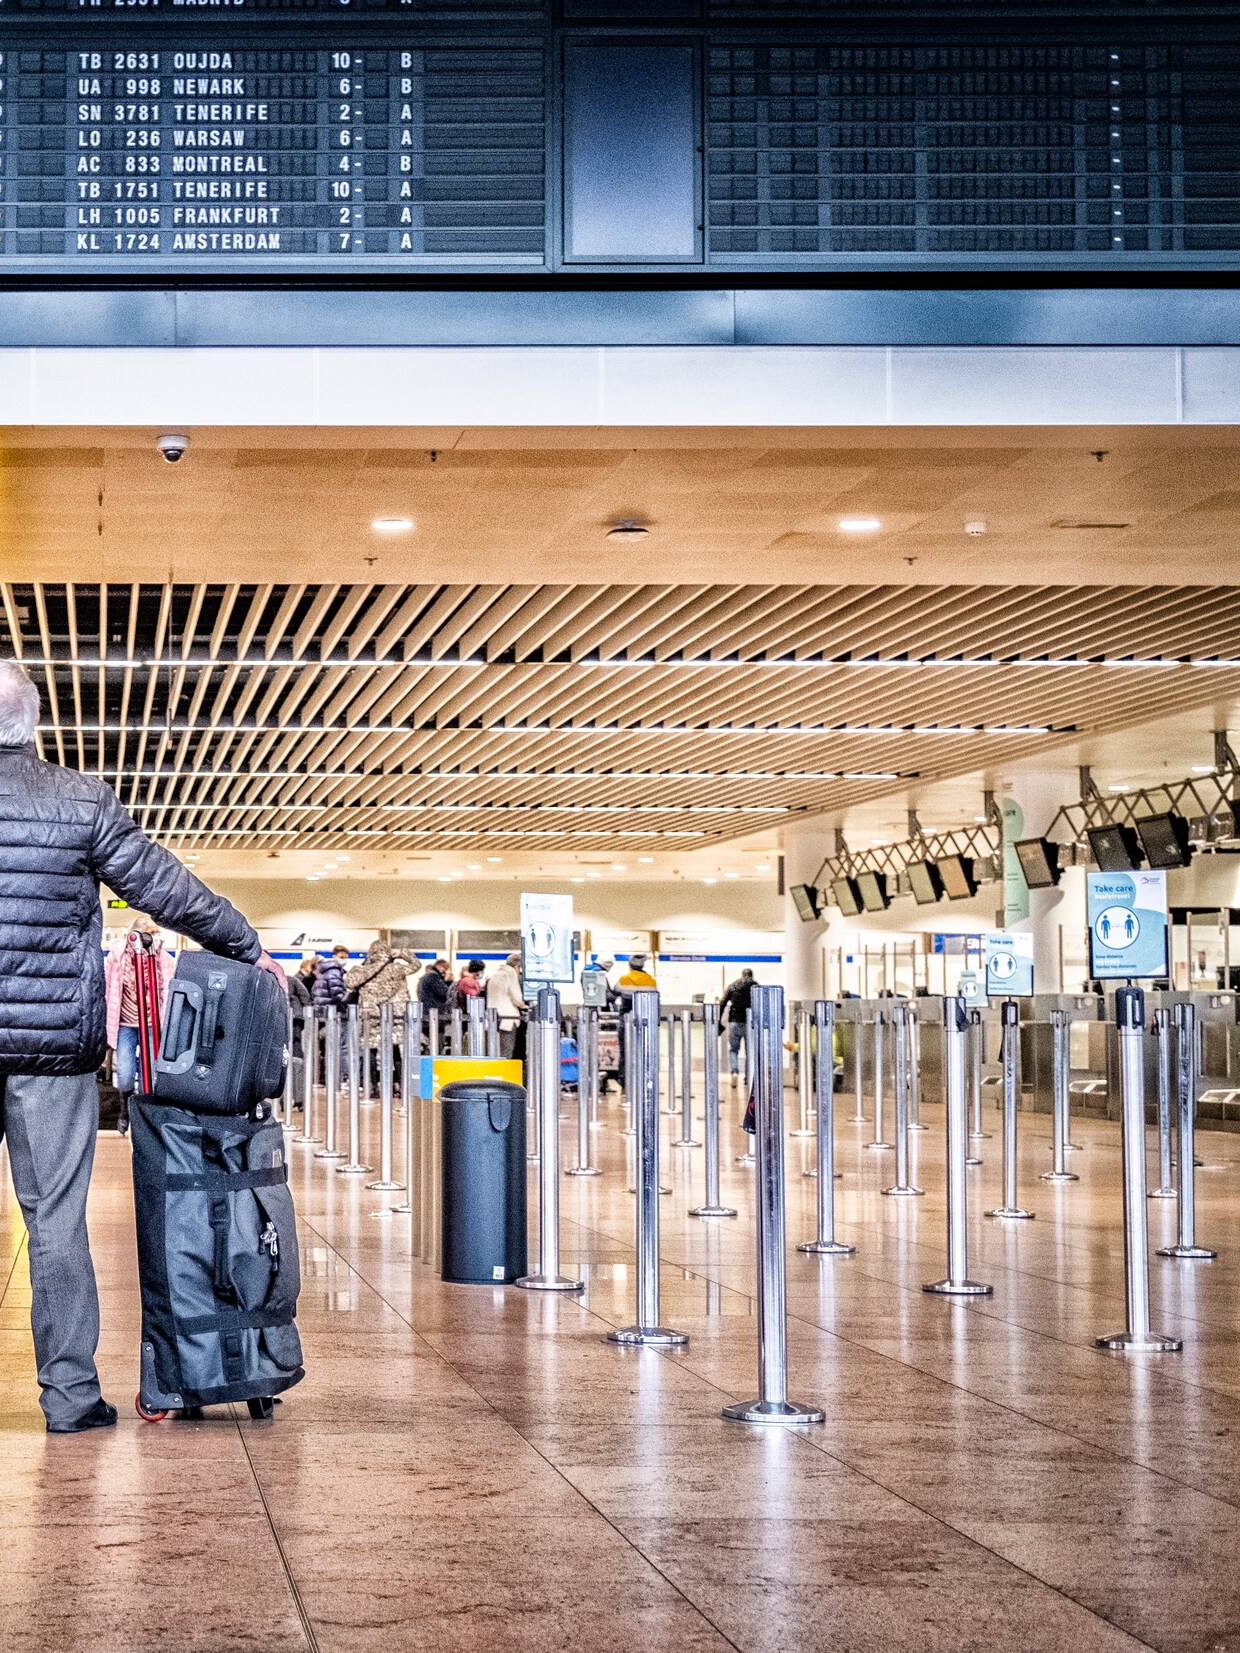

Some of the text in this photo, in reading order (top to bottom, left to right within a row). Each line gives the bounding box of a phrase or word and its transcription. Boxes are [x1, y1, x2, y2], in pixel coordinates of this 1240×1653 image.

[80, 54, 101, 68] TB
[115, 54, 158, 68] 2631
[174, 53, 232, 68] OUJDA
[402, 53, 411, 67] B
[79, 79, 100, 94] UA
[127, 79, 160, 94] 998
[174, 79, 244, 94] NEWARK
[402, 79, 411, 93] B
[79, 105, 101, 120] SN
[115, 105, 158, 120] 3781
[175, 105, 267, 120] TENERIFE
[401, 104, 411, 119] A
[79, 131, 100, 146] LO
[127, 131, 160, 146] 236
[174, 130, 244, 146] WARSAW
[401, 130, 411, 144] A
[78, 157, 100, 172] AC
[126, 157, 159, 172] 833
[173, 156, 267, 171] MONTREAL
[401, 156, 410, 171] B
[78, 182, 100, 197] TB
[115, 183, 157, 197] 1751
[174, 182, 267, 197] TENERIFE
[401, 182, 411, 196] A
[79, 209, 100, 223] LH
[115, 209, 159, 223] 1005
[174, 208, 279, 223] FRANKFURT
[401, 207, 411, 222] A
[77, 234, 99, 249] KL
[115, 234, 159, 249] 1724
[173, 234, 279, 249] AMSTERDAM
[401, 233, 411, 248] A
[1094, 885, 1114, 893] Take
